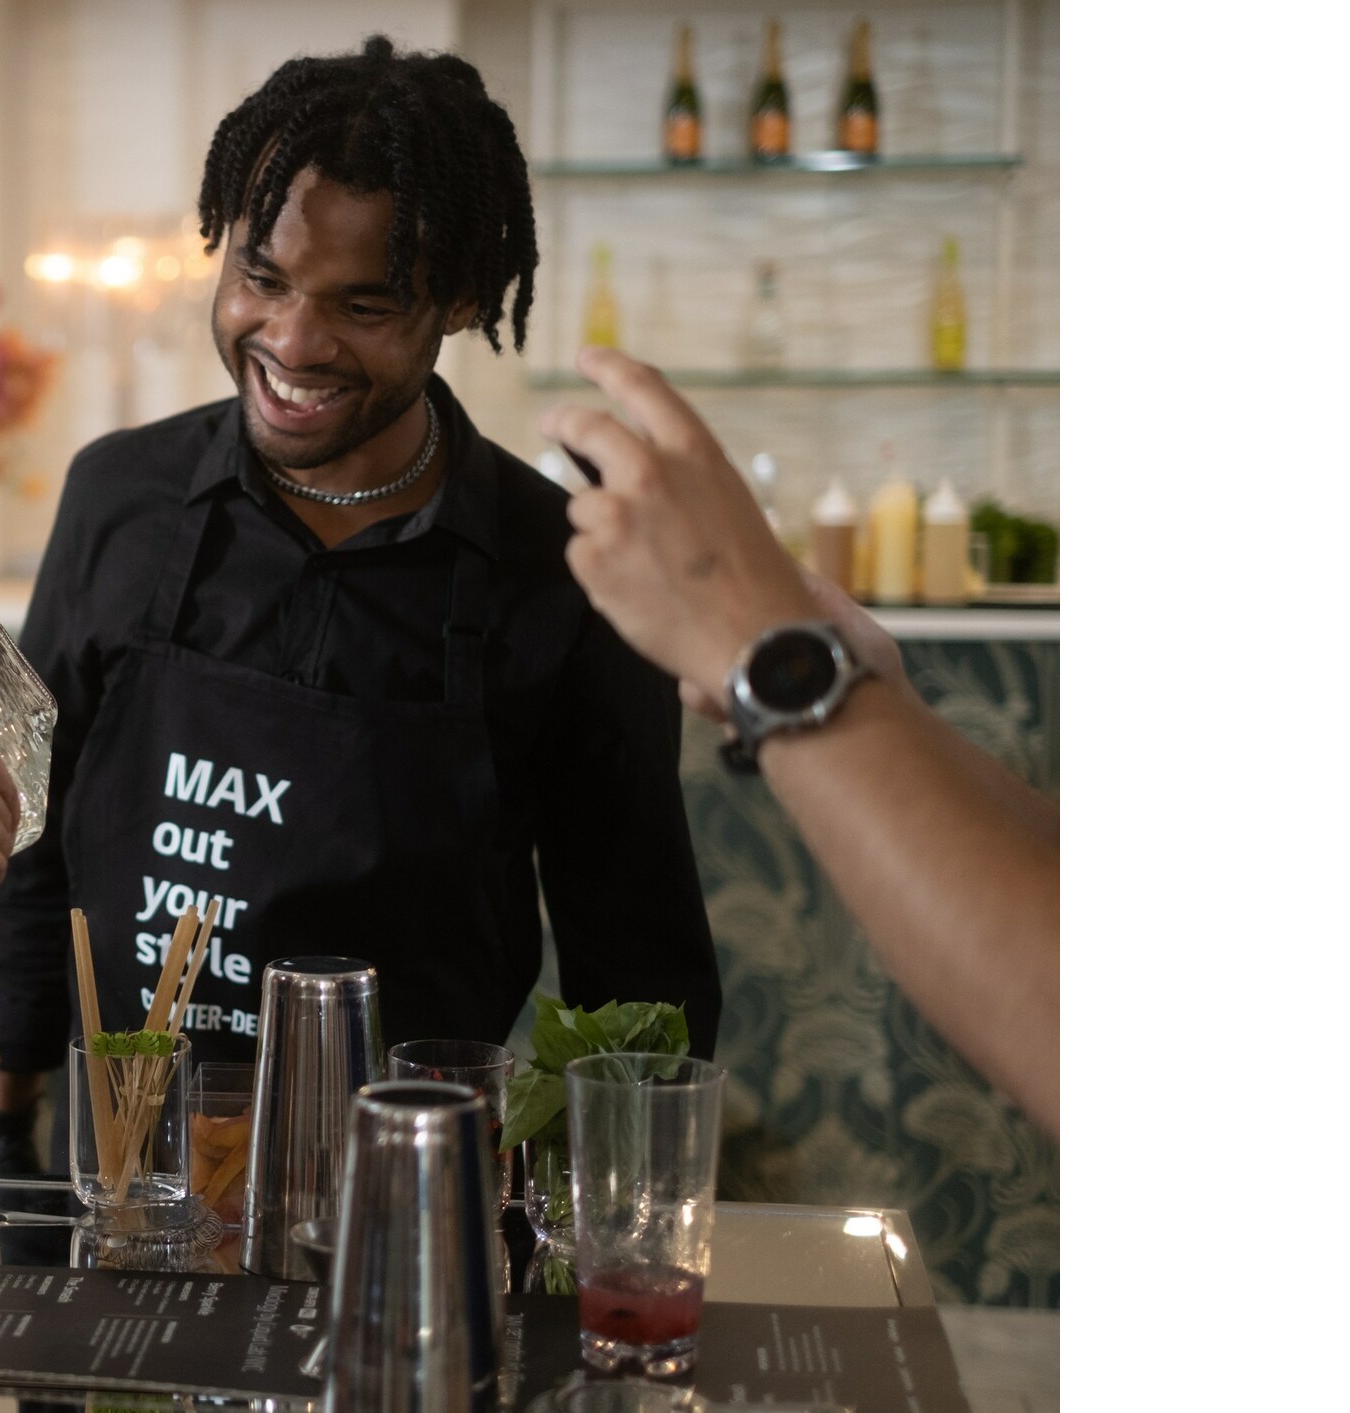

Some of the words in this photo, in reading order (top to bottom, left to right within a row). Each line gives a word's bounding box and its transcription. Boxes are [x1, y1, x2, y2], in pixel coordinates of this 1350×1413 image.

[163, 752, 291, 825] MAX
[152, 821, 233, 870] out
[135, 875, 248, 930] your
